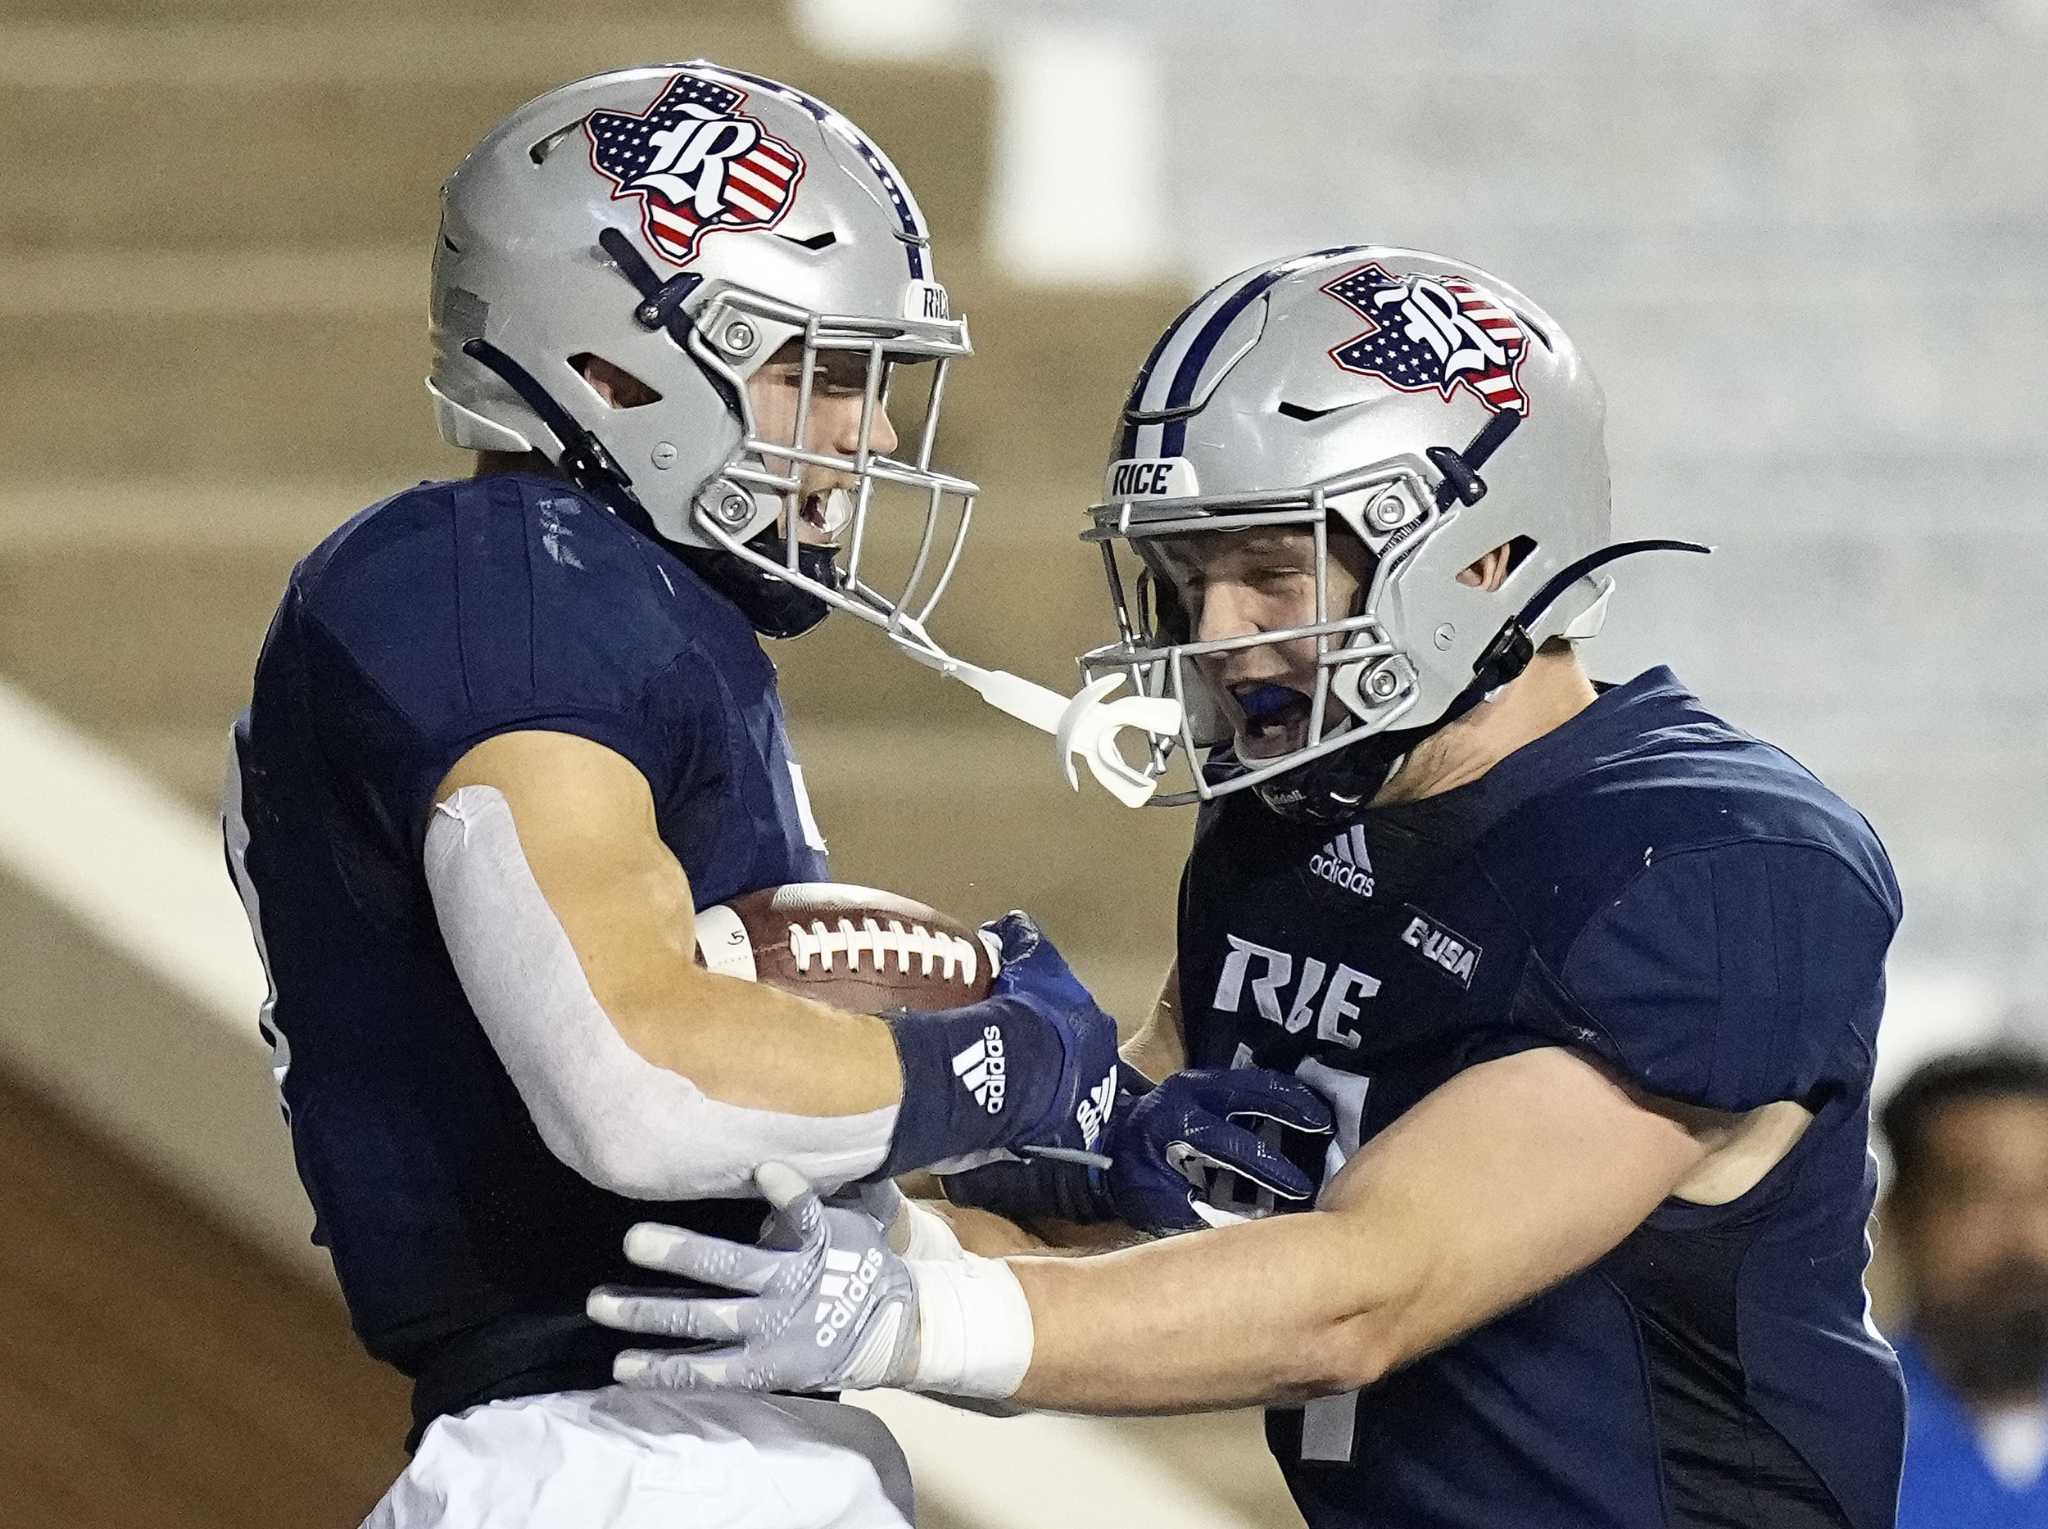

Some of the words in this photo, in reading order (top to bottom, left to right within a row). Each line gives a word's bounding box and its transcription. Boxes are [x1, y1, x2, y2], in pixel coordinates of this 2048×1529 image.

[1112, 463, 1174, 496] RICE
[1309, 854, 1375, 897] adidas
[727, 929, 745, 946] 5
[982, 1025, 1006, 1114] adidas
[815, 1247, 884, 1348] adidas
